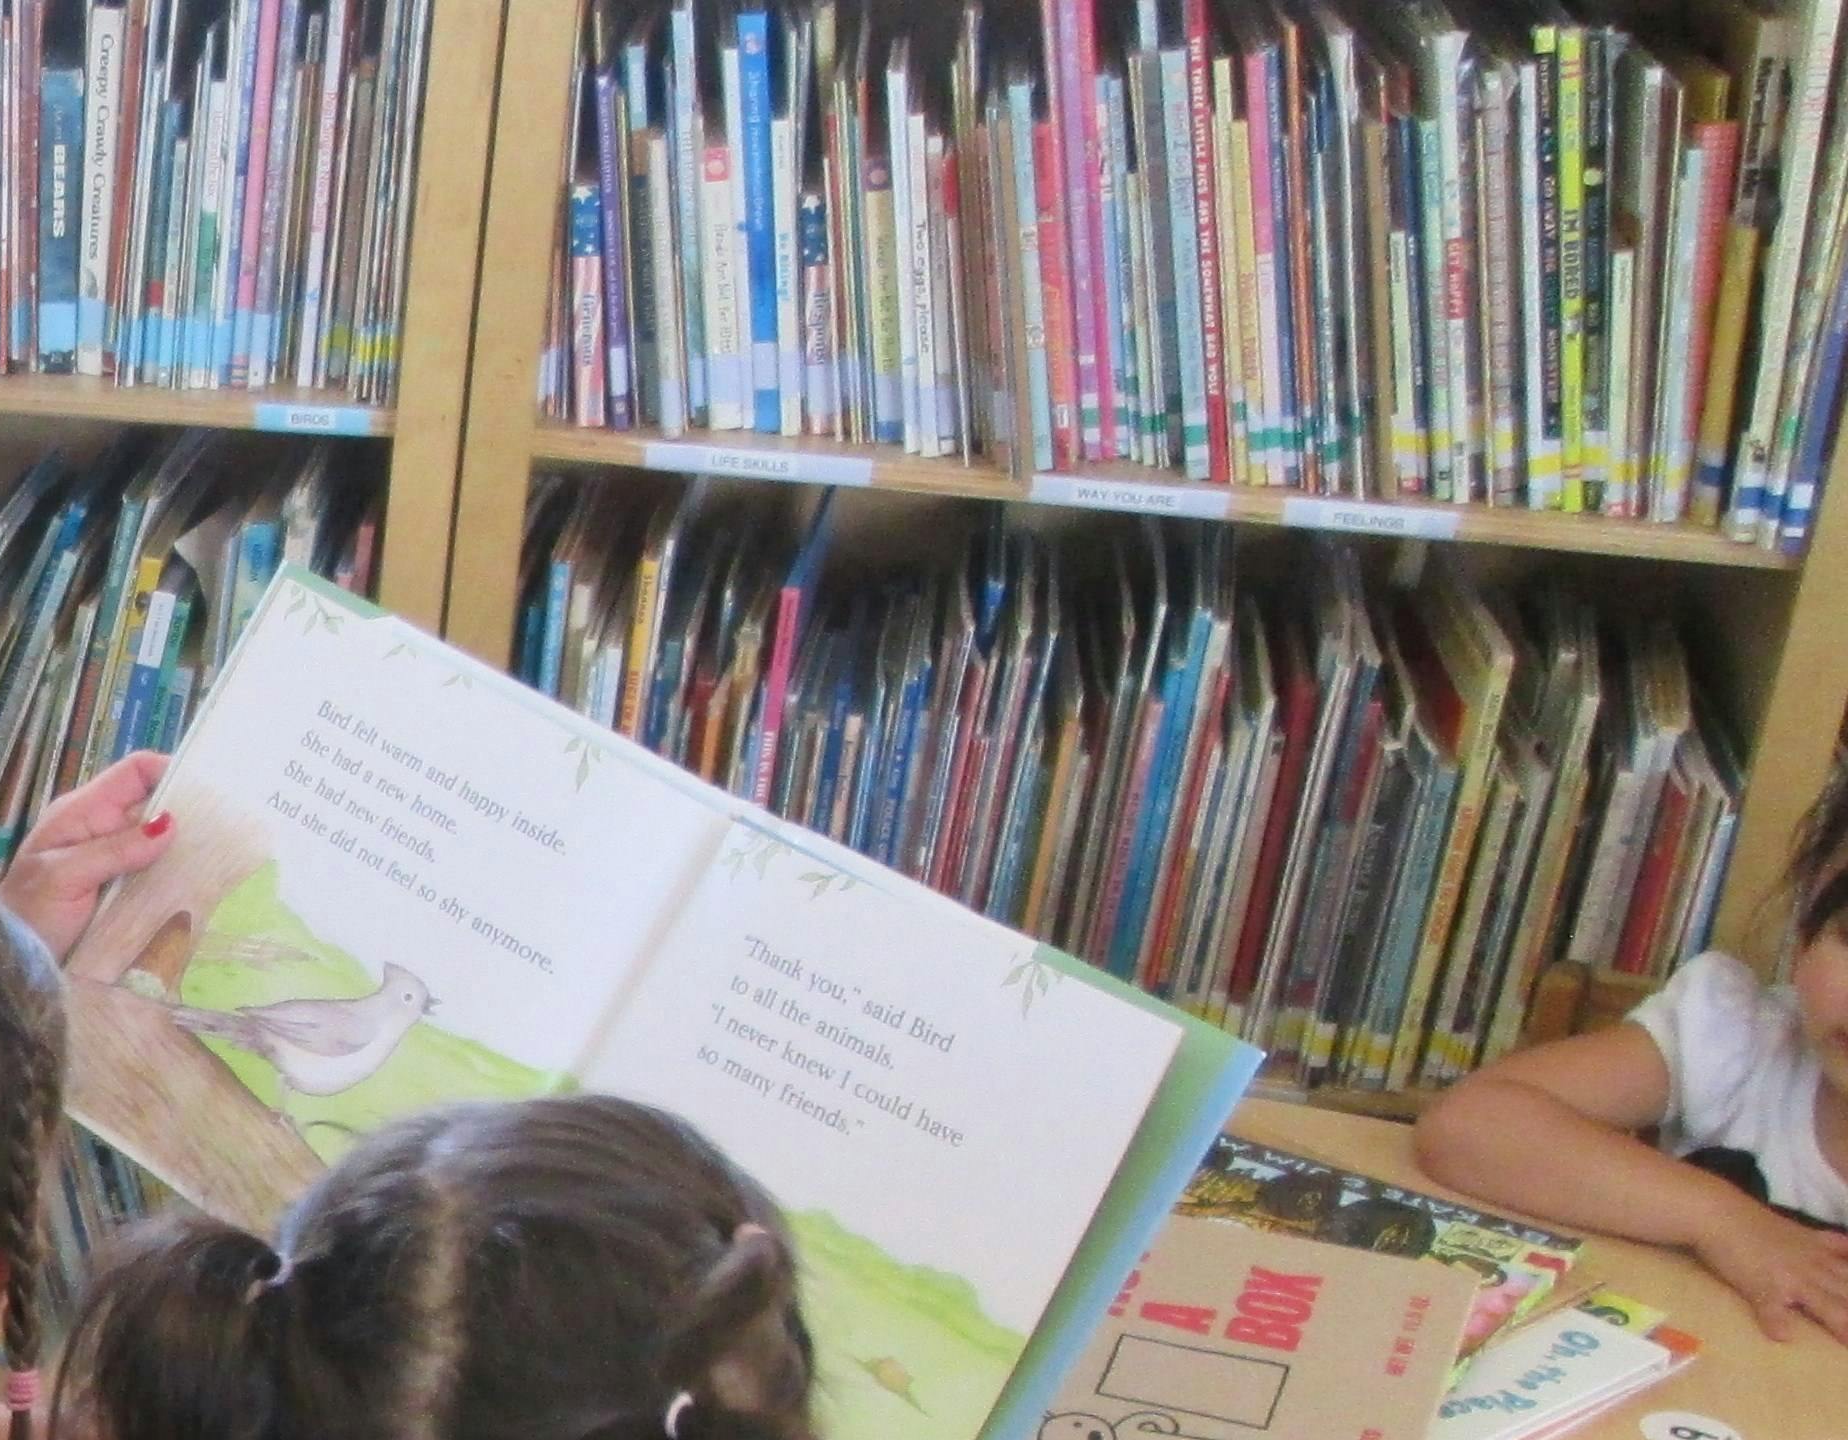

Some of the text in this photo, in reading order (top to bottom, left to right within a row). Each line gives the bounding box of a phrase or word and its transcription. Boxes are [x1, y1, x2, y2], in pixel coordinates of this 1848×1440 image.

[88, 33, 115, 260] Creepy Crawly Creatures
[53, 144, 66, 238] BEARS
[1190, 37, 1219, 395] THE THREE LITTLE PIGS AND THE SOMEWHAT BAD WOLF
[913, 222, 930, 354] Two eggs, please
[1562, 240, 1580, 299] BORED
[290, 415, 330, 428] BIRDS
[711, 454, 790, 473] LIFE SKILLS
[1077, 486, 1176, 507] WAY YOU ARE
[1334, 512, 1405, 529] FEELINGS
[284, 759, 313, 788] She
[315, 777, 345, 805] had
[348, 800, 379, 827] new
[301, 730, 458, 835] She had a new home.
[317, 700, 567, 856] Bird felt warm and happy inside.
[266, 790, 554, 974] And she did not feel so shy anymore.
[730, 974, 748, 996] to
[753, 982, 778, 1010] all
[780, 996, 811, 1028] the
[863, 998, 904, 1029] said
[908, 1016, 956, 1053] Bird
[697, 1045, 720, 1066] so
[721, 1056, 775, 1097] many
[726, 1016, 778, 1054] never
[781, 1041, 835, 1082] knew
[839, 1069, 851, 1090] I
[854, 1081, 914, 1121] could
[915, 1108, 964, 1148] have
[1263, 1149, 1331, 1176] JIM
[1382, 1186, 1480, 1225] KATE
[1139, 1301, 1217, 1335] A
[1223, 1266, 1324, 1352] BOX
[1515, 1362, 1567, 1392] the
